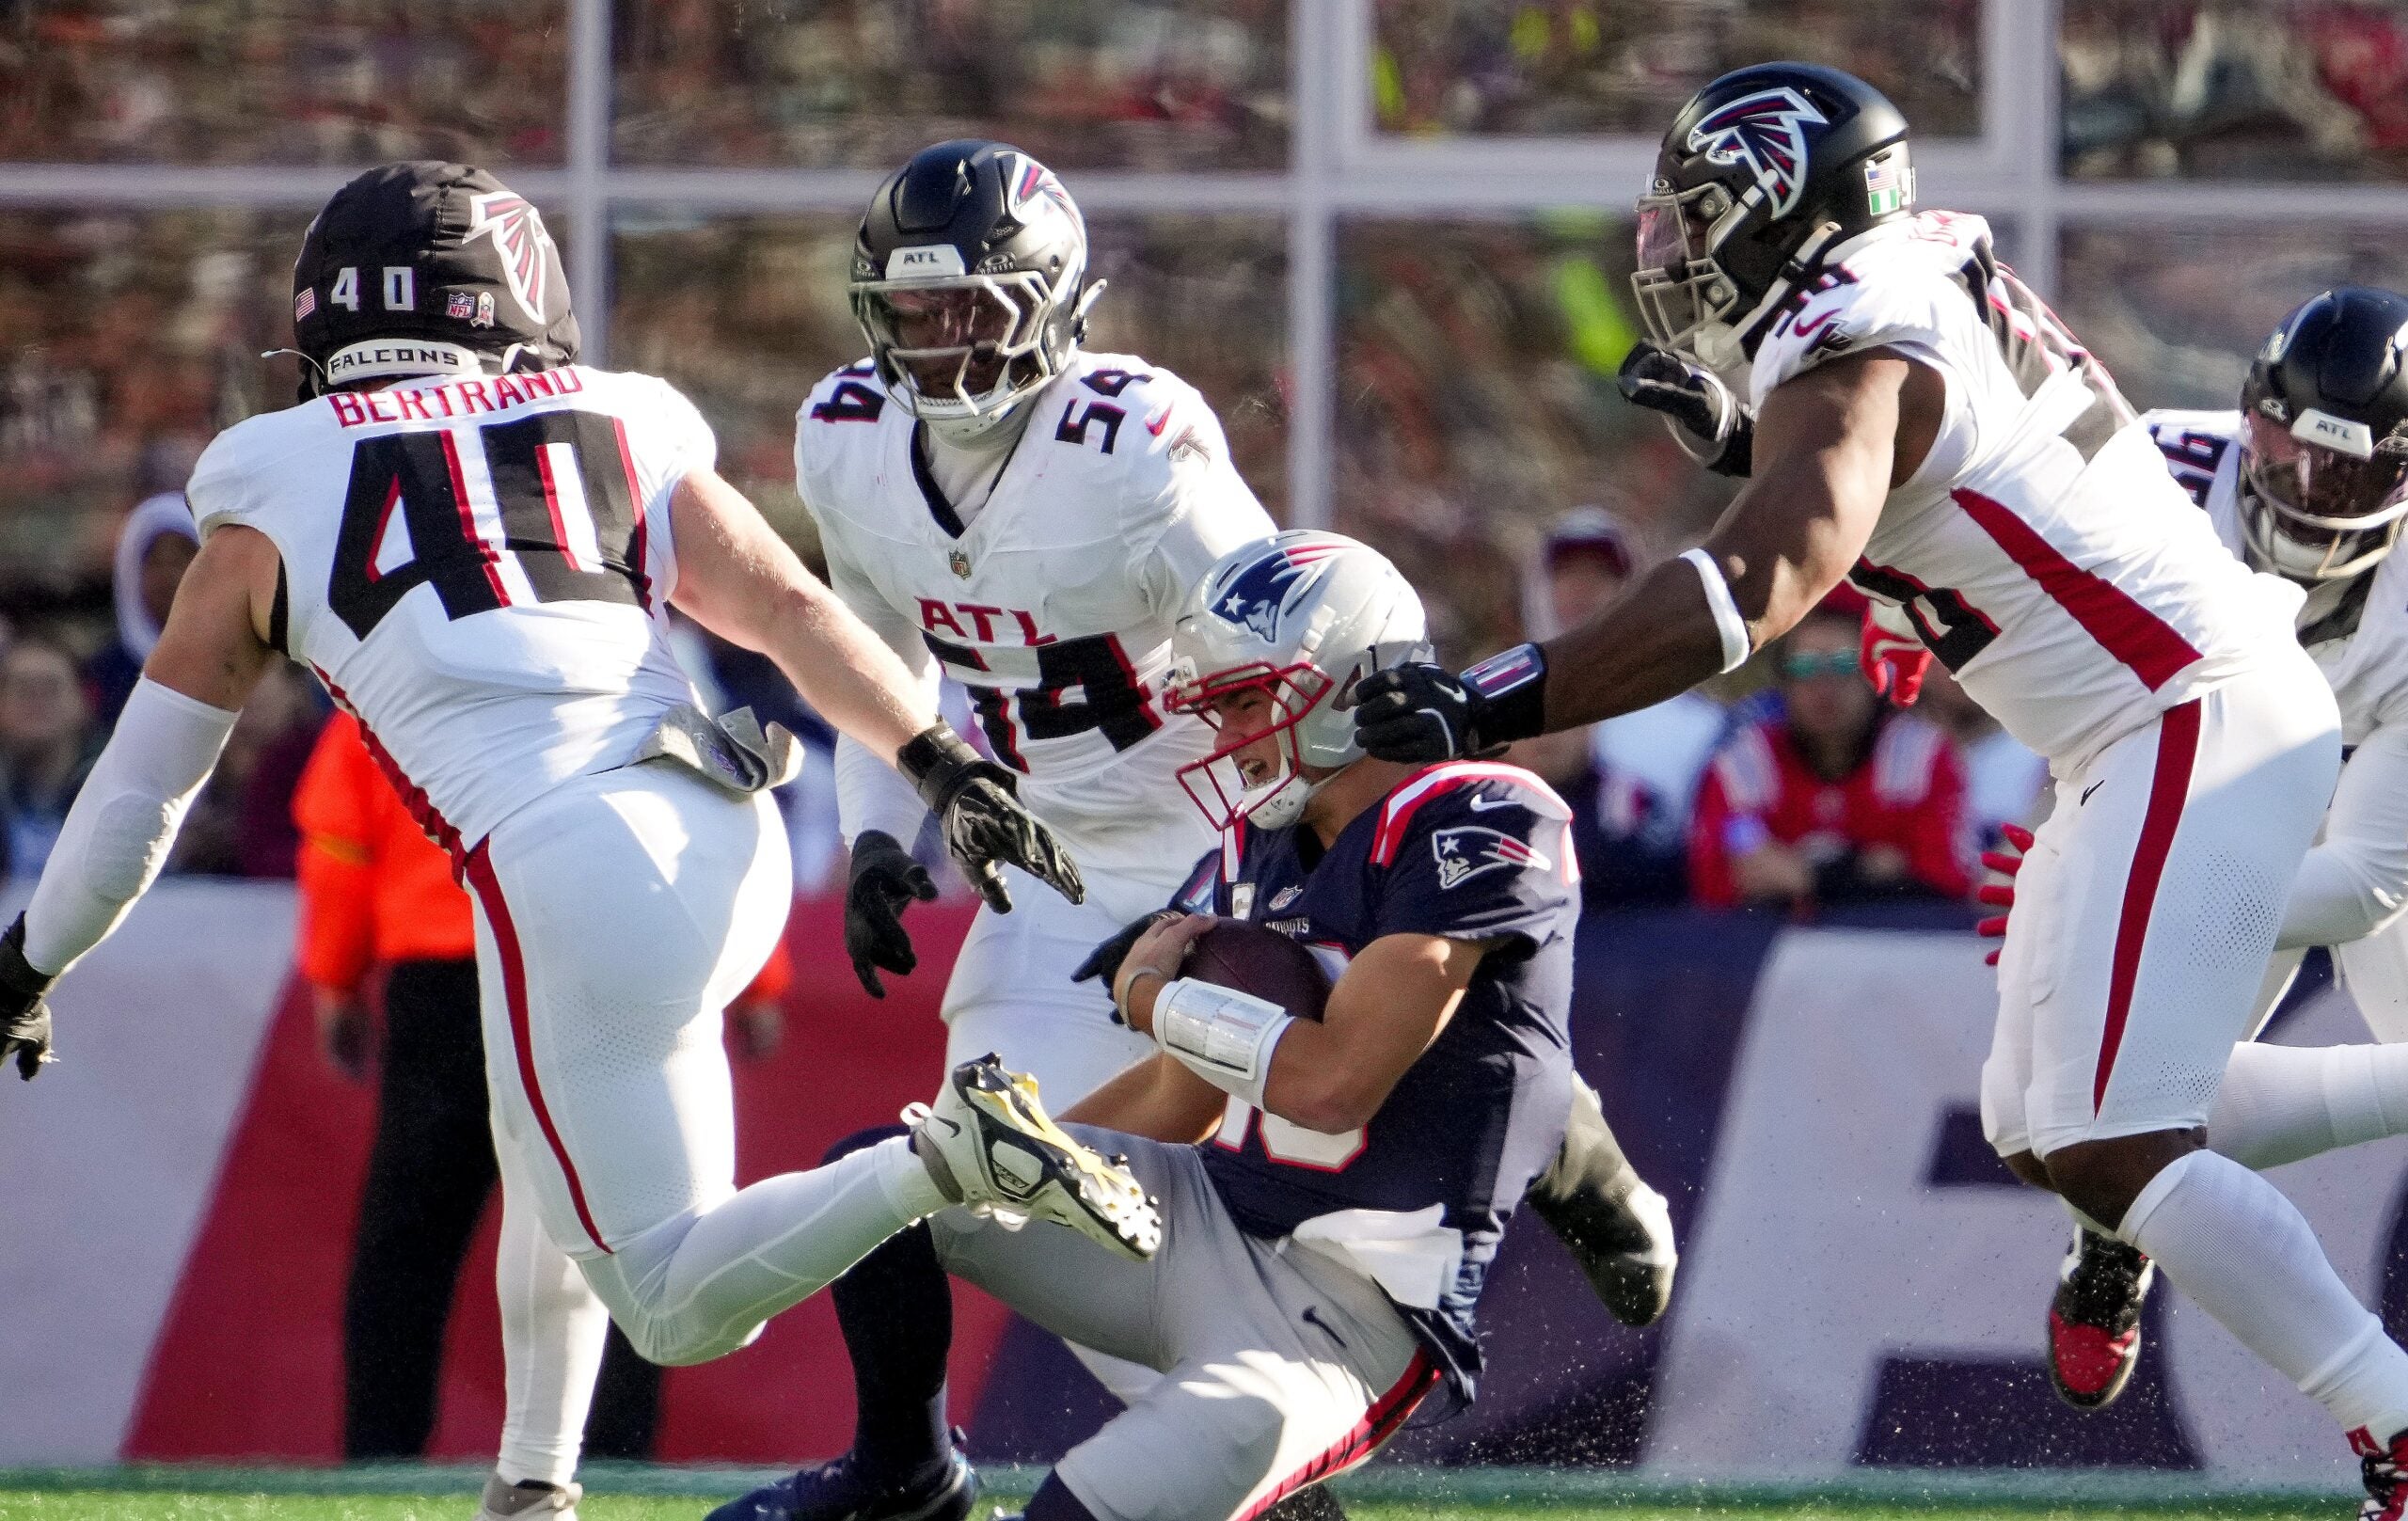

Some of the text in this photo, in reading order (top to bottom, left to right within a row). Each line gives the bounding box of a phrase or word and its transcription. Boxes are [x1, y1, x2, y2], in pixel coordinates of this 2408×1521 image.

[903, 252, 940, 264] ATL
[331, 267, 415, 311] 40
[329, 348, 459, 374] FALCONS
[327, 366, 583, 428] BERTRAND
[1054, 369, 1156, 455] 54
[2315, 420, 2352, 439] ATL
[327, 409, 655, 642] 40
[913, 596, 1058, 647] ATL
[920, 631, 1164, 775] 54
